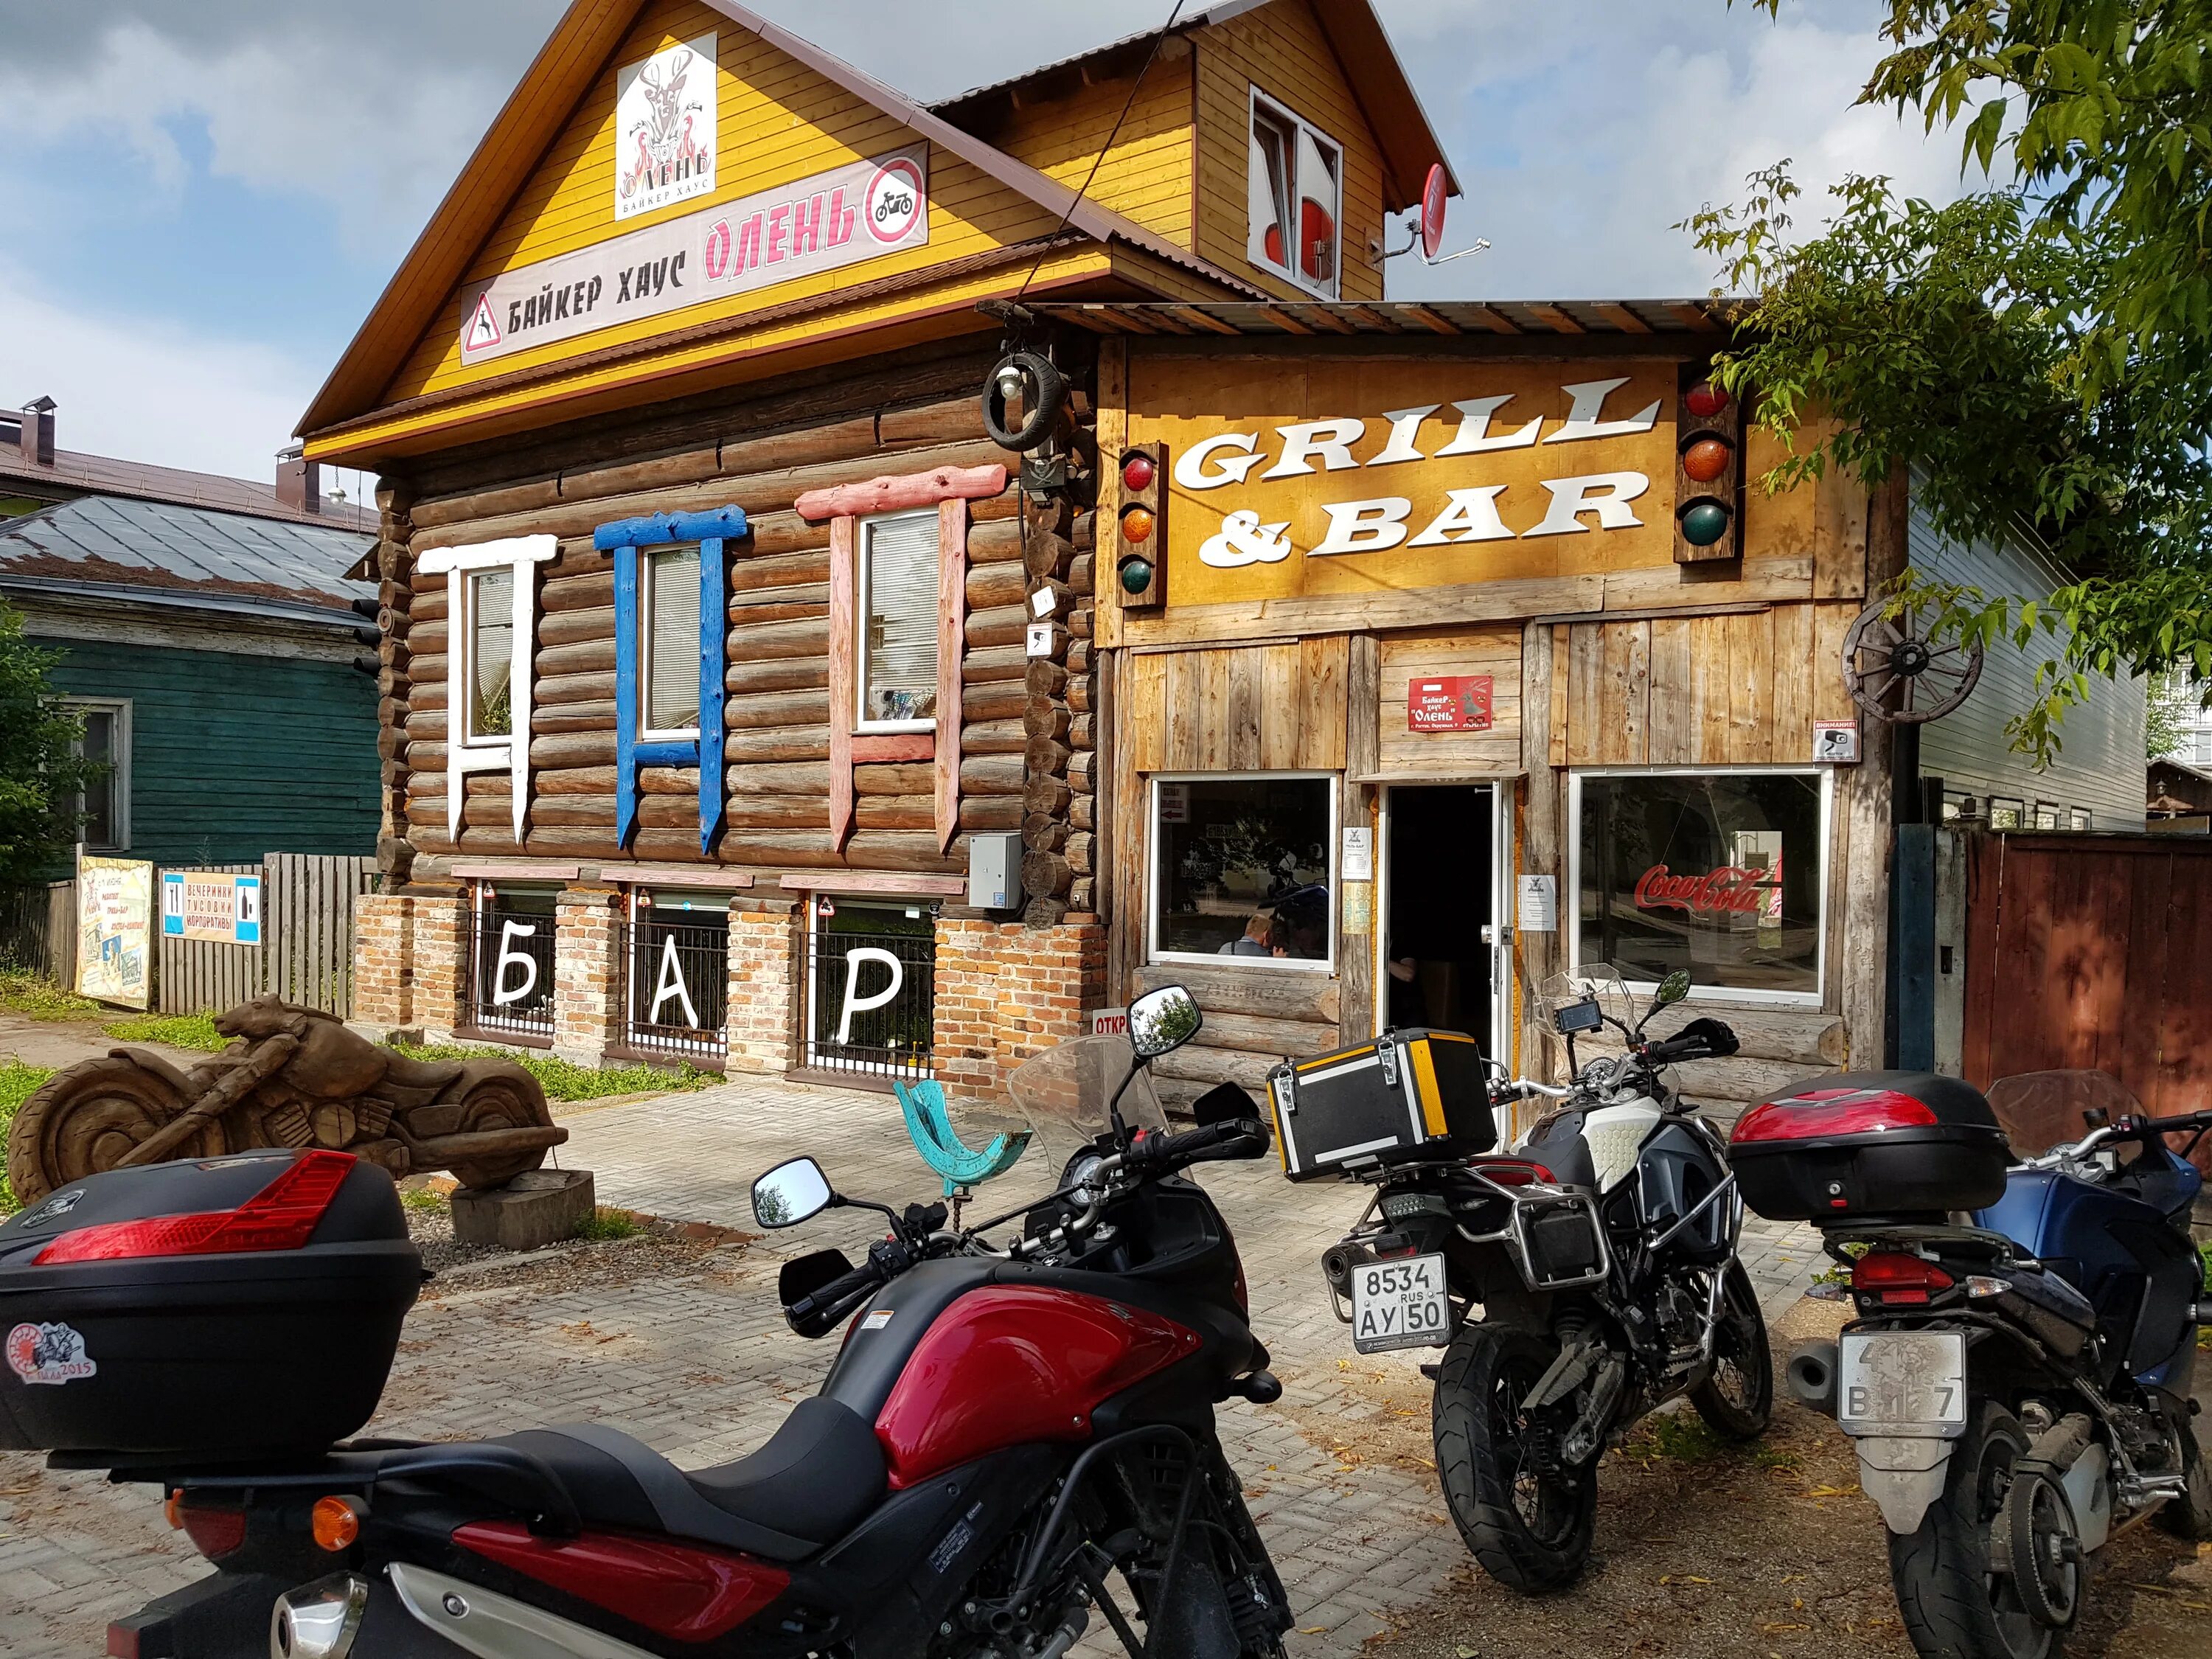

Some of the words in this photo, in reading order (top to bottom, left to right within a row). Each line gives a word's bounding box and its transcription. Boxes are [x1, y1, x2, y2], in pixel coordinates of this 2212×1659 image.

[624, 153, 708, 198] ОЛЕНЬ
[623, 192, 669, 212] БАЙКЕР
[677, 179, 709, 196] ХАУС
[507, 274, 602, 335] БАЙКЕР
[616, 251, 686, 305] ХАУС
[703, 184, 857, 282] ОЛЕНЬ
[1174, 376, 1663, 490] GRILL
[1197, 509, 1292, 568] &
[1306, 471, 1650, 557] BAR
[187, 884, 232, 898] ВЕЧЕРИНКИ
[187, 899, 232, 914] ТУСОВКИ
[187, 915, 232, 930] КОРПОРАТИВЫ
[1366, 1263, 1430, 1296] 8534
[1401, 1291, 1423, 1303] RUS
[1360, 1307, 1397, 1336] АУ
[1408, 1301, 1439, 1329] 50
[60, 1362, 91, 1376] 2015
